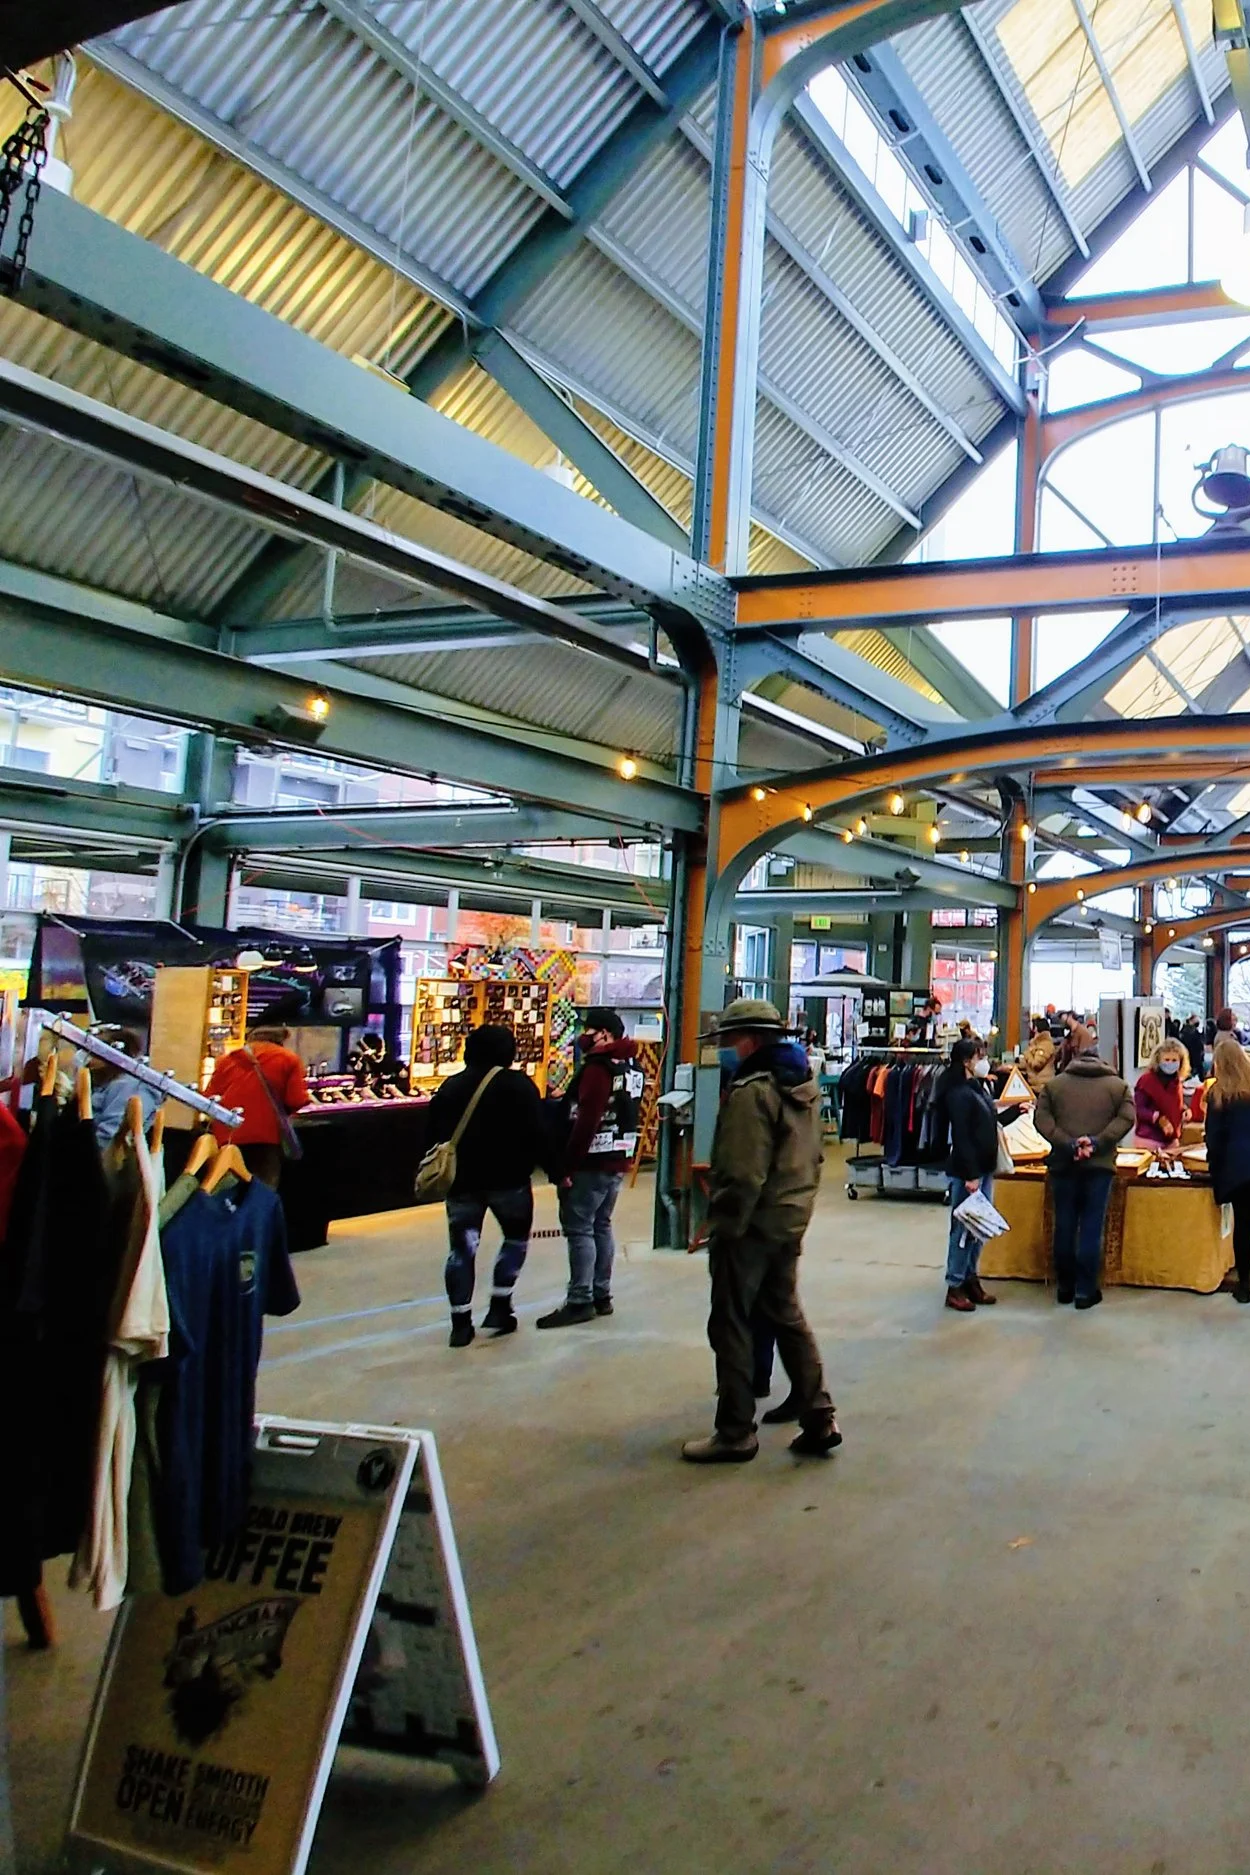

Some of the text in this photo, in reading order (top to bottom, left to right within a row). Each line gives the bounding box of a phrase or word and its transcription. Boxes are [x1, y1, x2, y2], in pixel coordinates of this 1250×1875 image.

[204, 1532, 335, 1595] OFFEE
[124, 1745, 191, 1784] SHAKE
[195, 1763, 271, 1798] SMOOTH
[116, 1773, 186, 1824] OPEN
